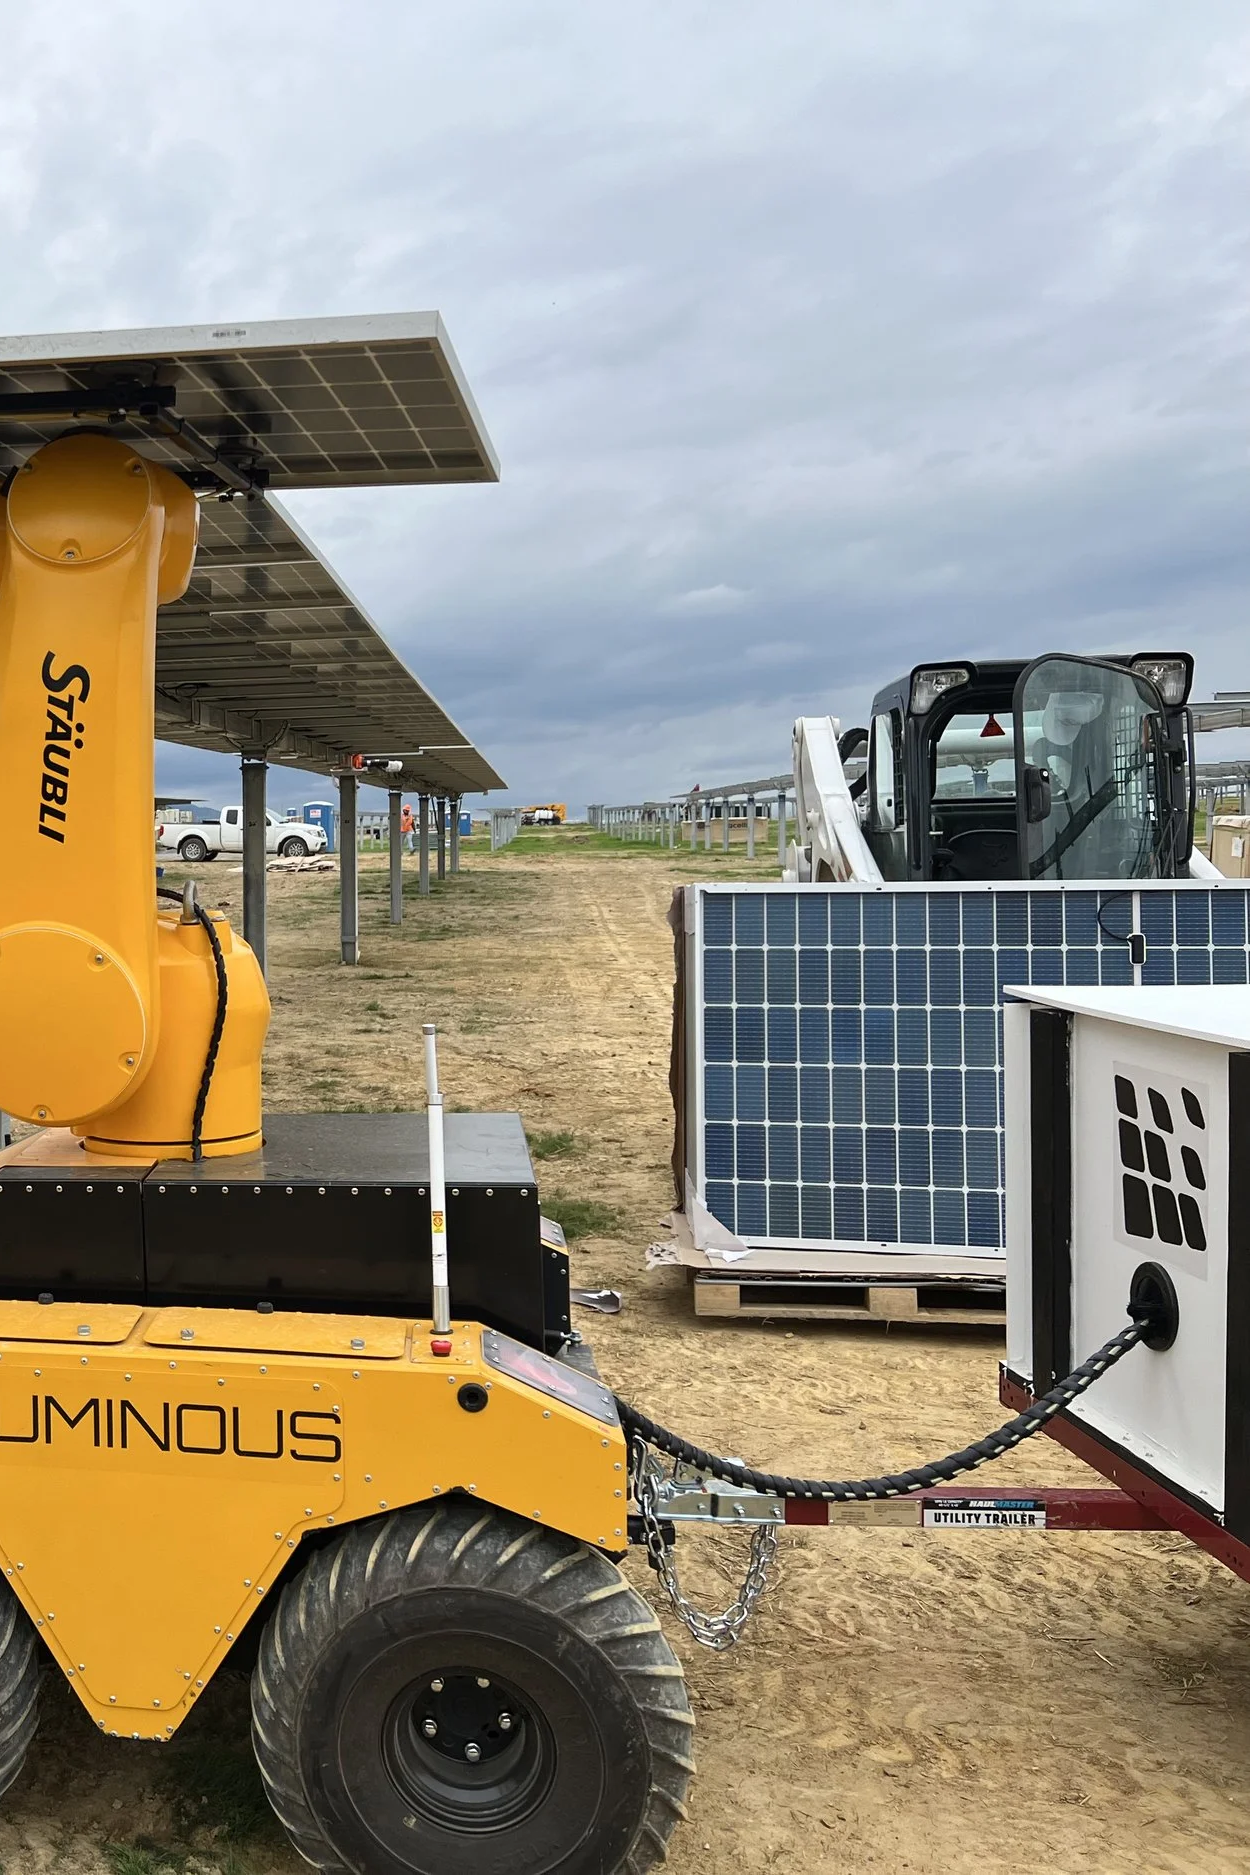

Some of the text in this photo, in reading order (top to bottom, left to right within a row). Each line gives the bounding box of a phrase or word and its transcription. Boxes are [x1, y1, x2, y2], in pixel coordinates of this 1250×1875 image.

[38, 650, 91, 844] STÄUBLI
[934, 1512, 981, 1524] UTILITY
[985, 1513, 1036, 1525] TRAILER
